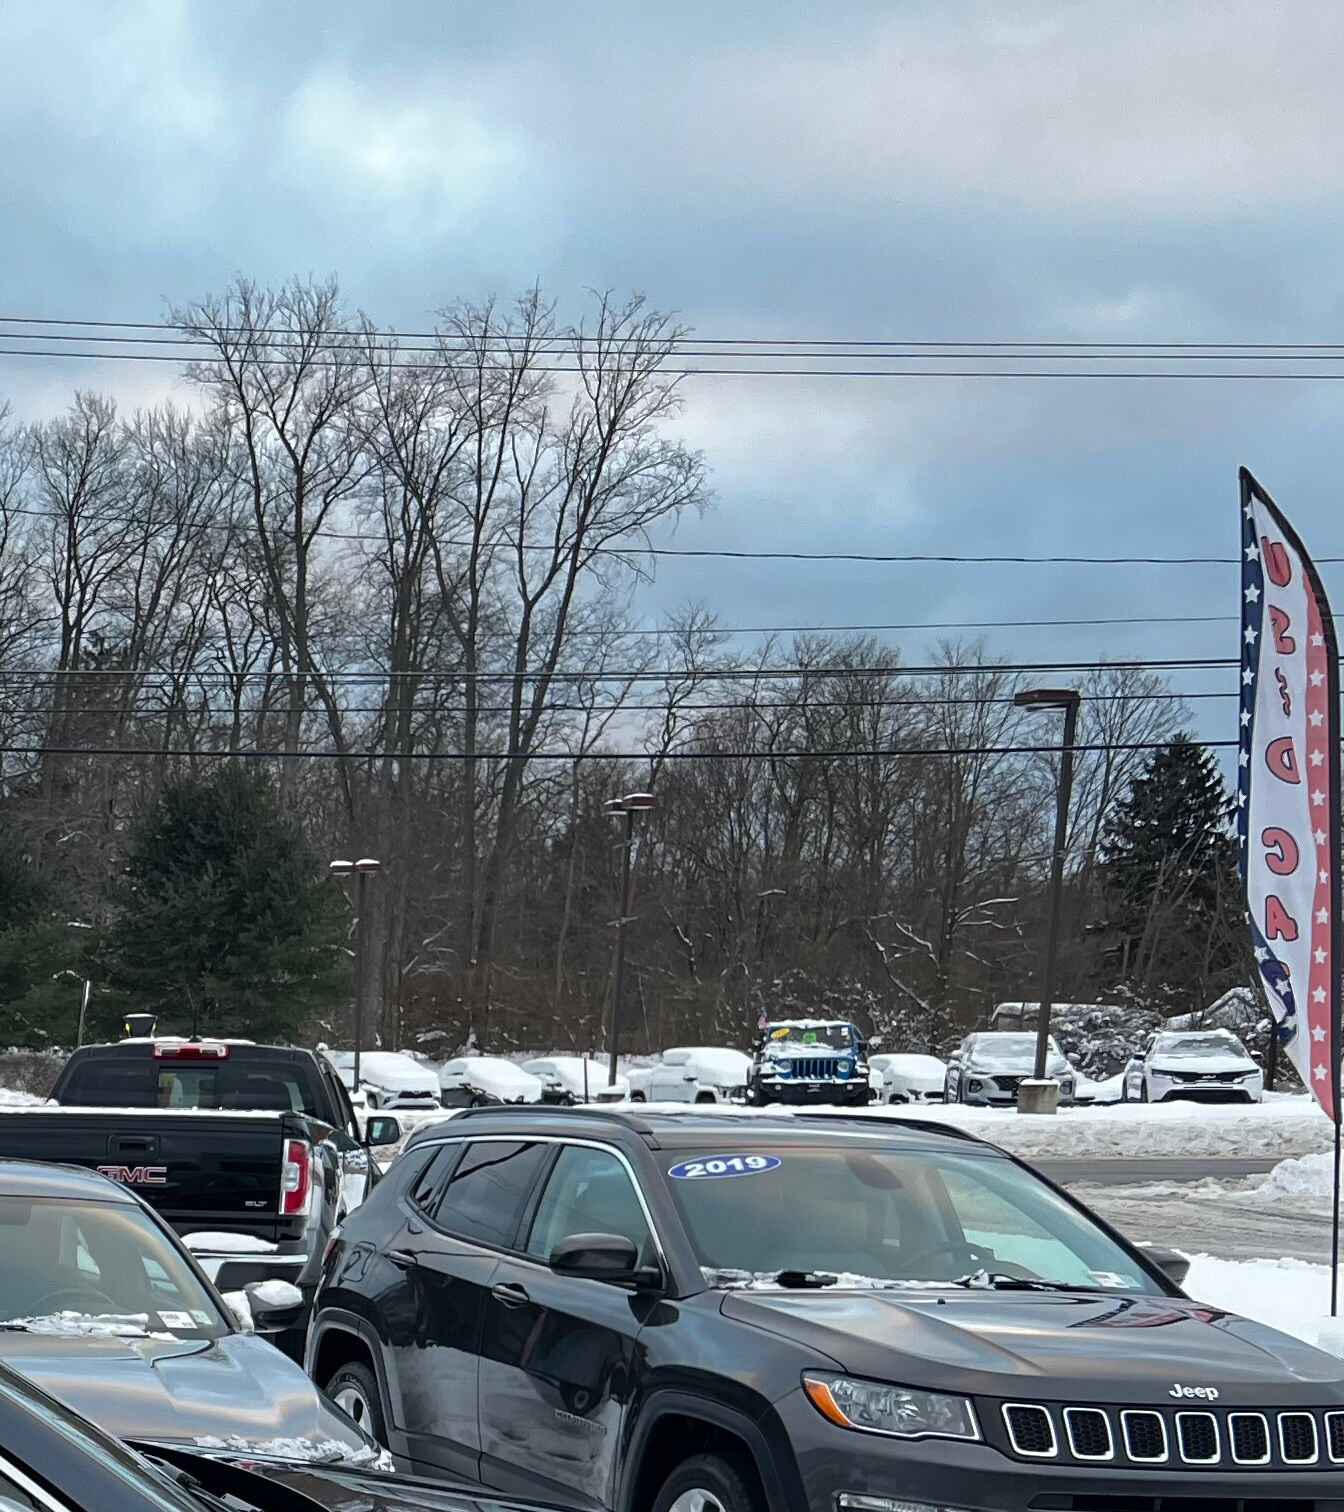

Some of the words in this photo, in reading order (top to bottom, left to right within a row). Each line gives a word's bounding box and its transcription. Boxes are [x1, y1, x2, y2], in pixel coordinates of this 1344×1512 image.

[96, 1164, 167, 1184] GMC
[684, 1156, 768, 1177] 2019
[1168, 1383, 1219, 1402] Jeep
